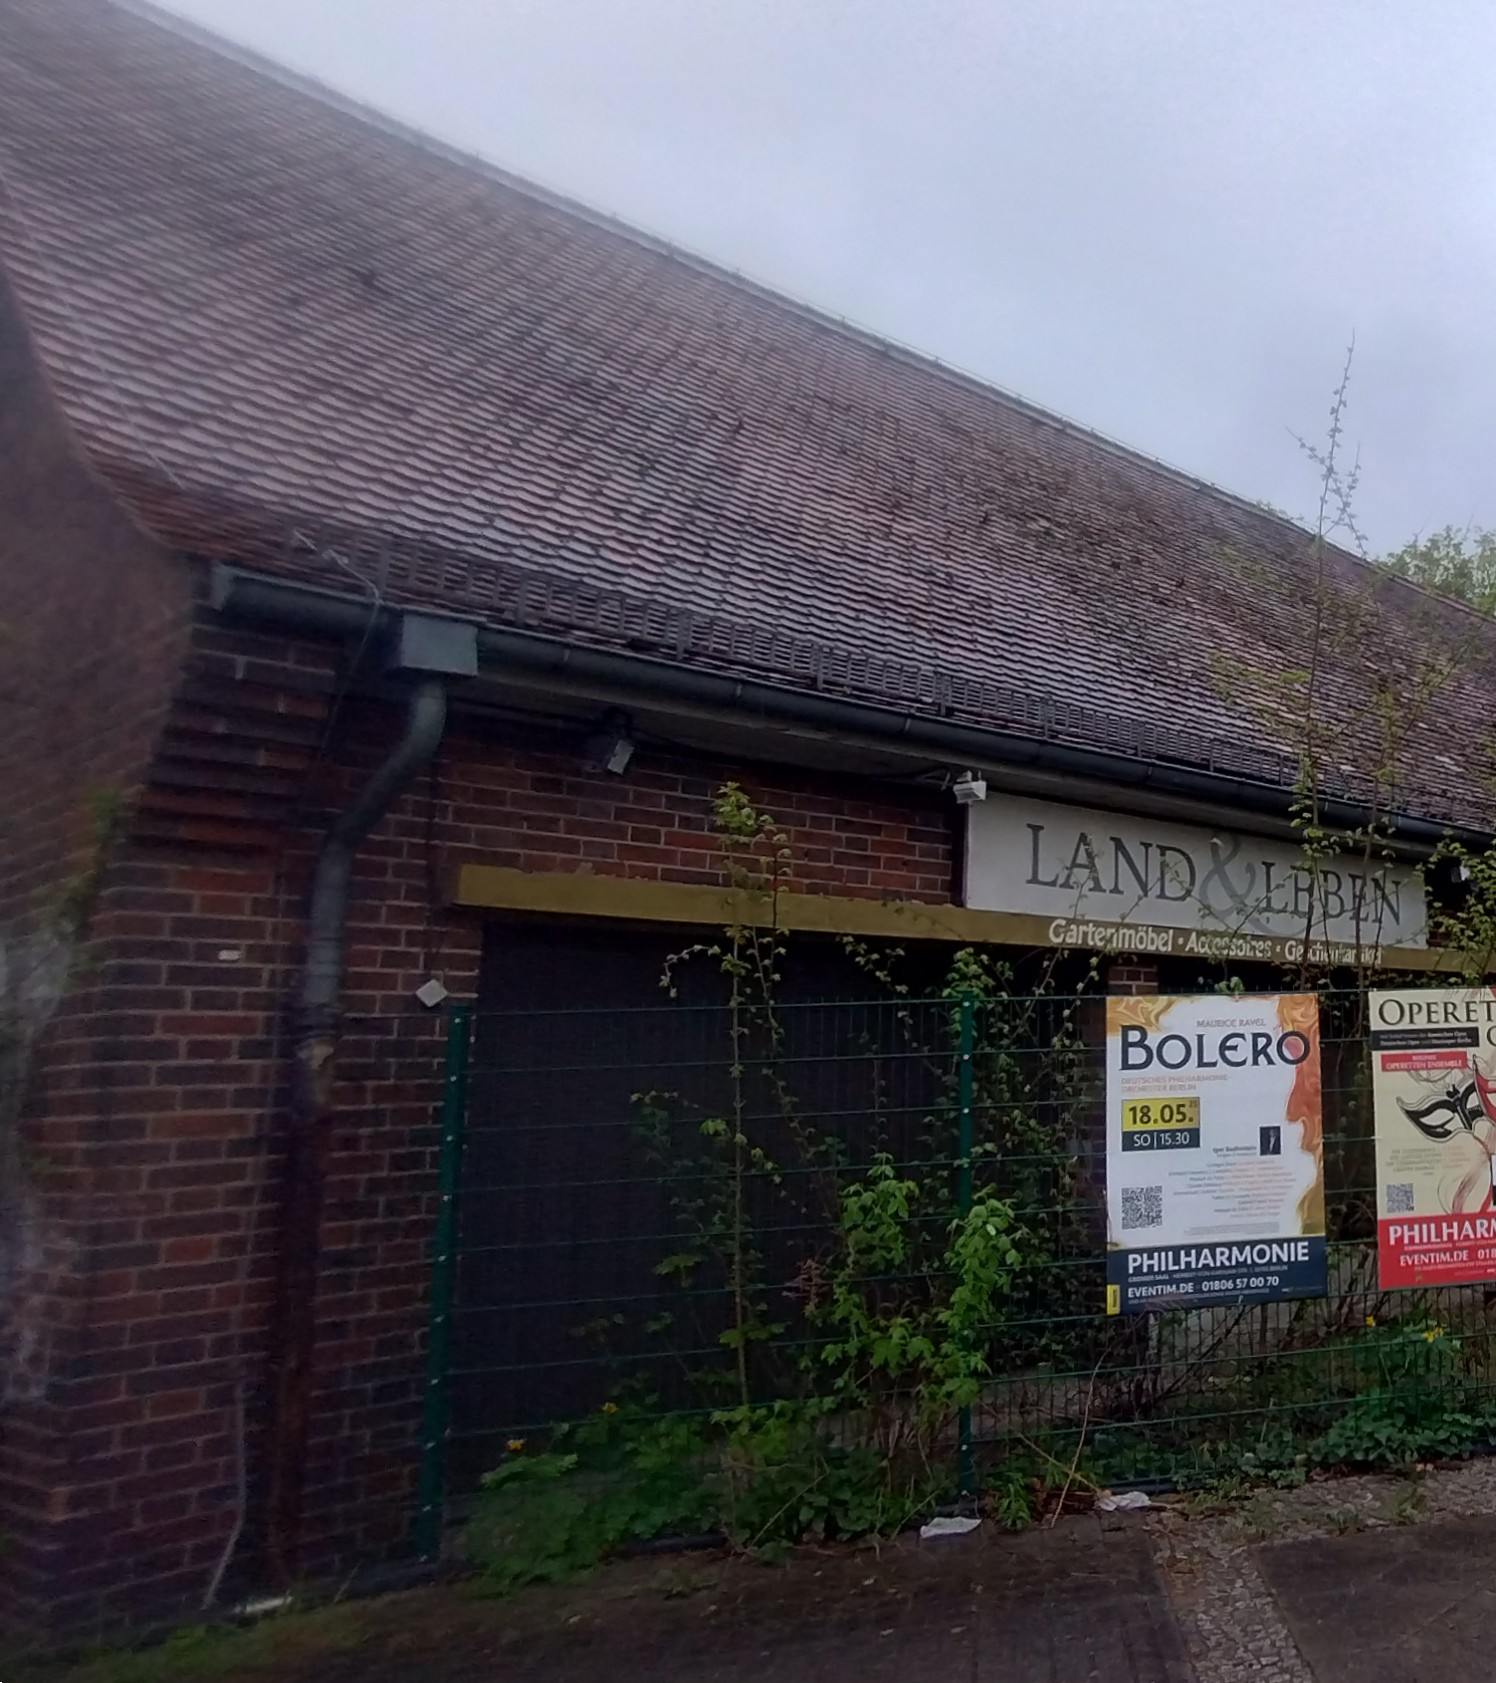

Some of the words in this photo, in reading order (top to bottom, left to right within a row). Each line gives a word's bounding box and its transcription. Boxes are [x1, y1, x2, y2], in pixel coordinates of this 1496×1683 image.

[1049, 918, 1174, 952] Gartenmöbel
[1239, 1018, 1266, 1028] RAVEL
[1119, 1024, 1310, 1071] BOLERO
[1386, 1061, 1426, 1070] OPERETTEN
[1427, 1059, 1463, 1069] ENSEMBLE
[1169, 1083, 1196, 1092] BERLIN
[1129, 1103, 1194, 1125] 18.05.
[1133, 1133, 1151, 1147] SO
[1160, 1131, 1190, 1146] 15.30
[1128, 1241, 1309, 1275] PHILHARMONIE
[1400, 1250, 1469, 1267] EVENTIM.DE
[1128, 1283, 1194, 1298] EVENTIM.DE
[1201, 1278, 1234, 1292] 01806
[1236, 1278, 1248, 1289] 57
[1250, 1276, 1265, 1287] 00
[1266, 1275, 1279, 1286] 70
